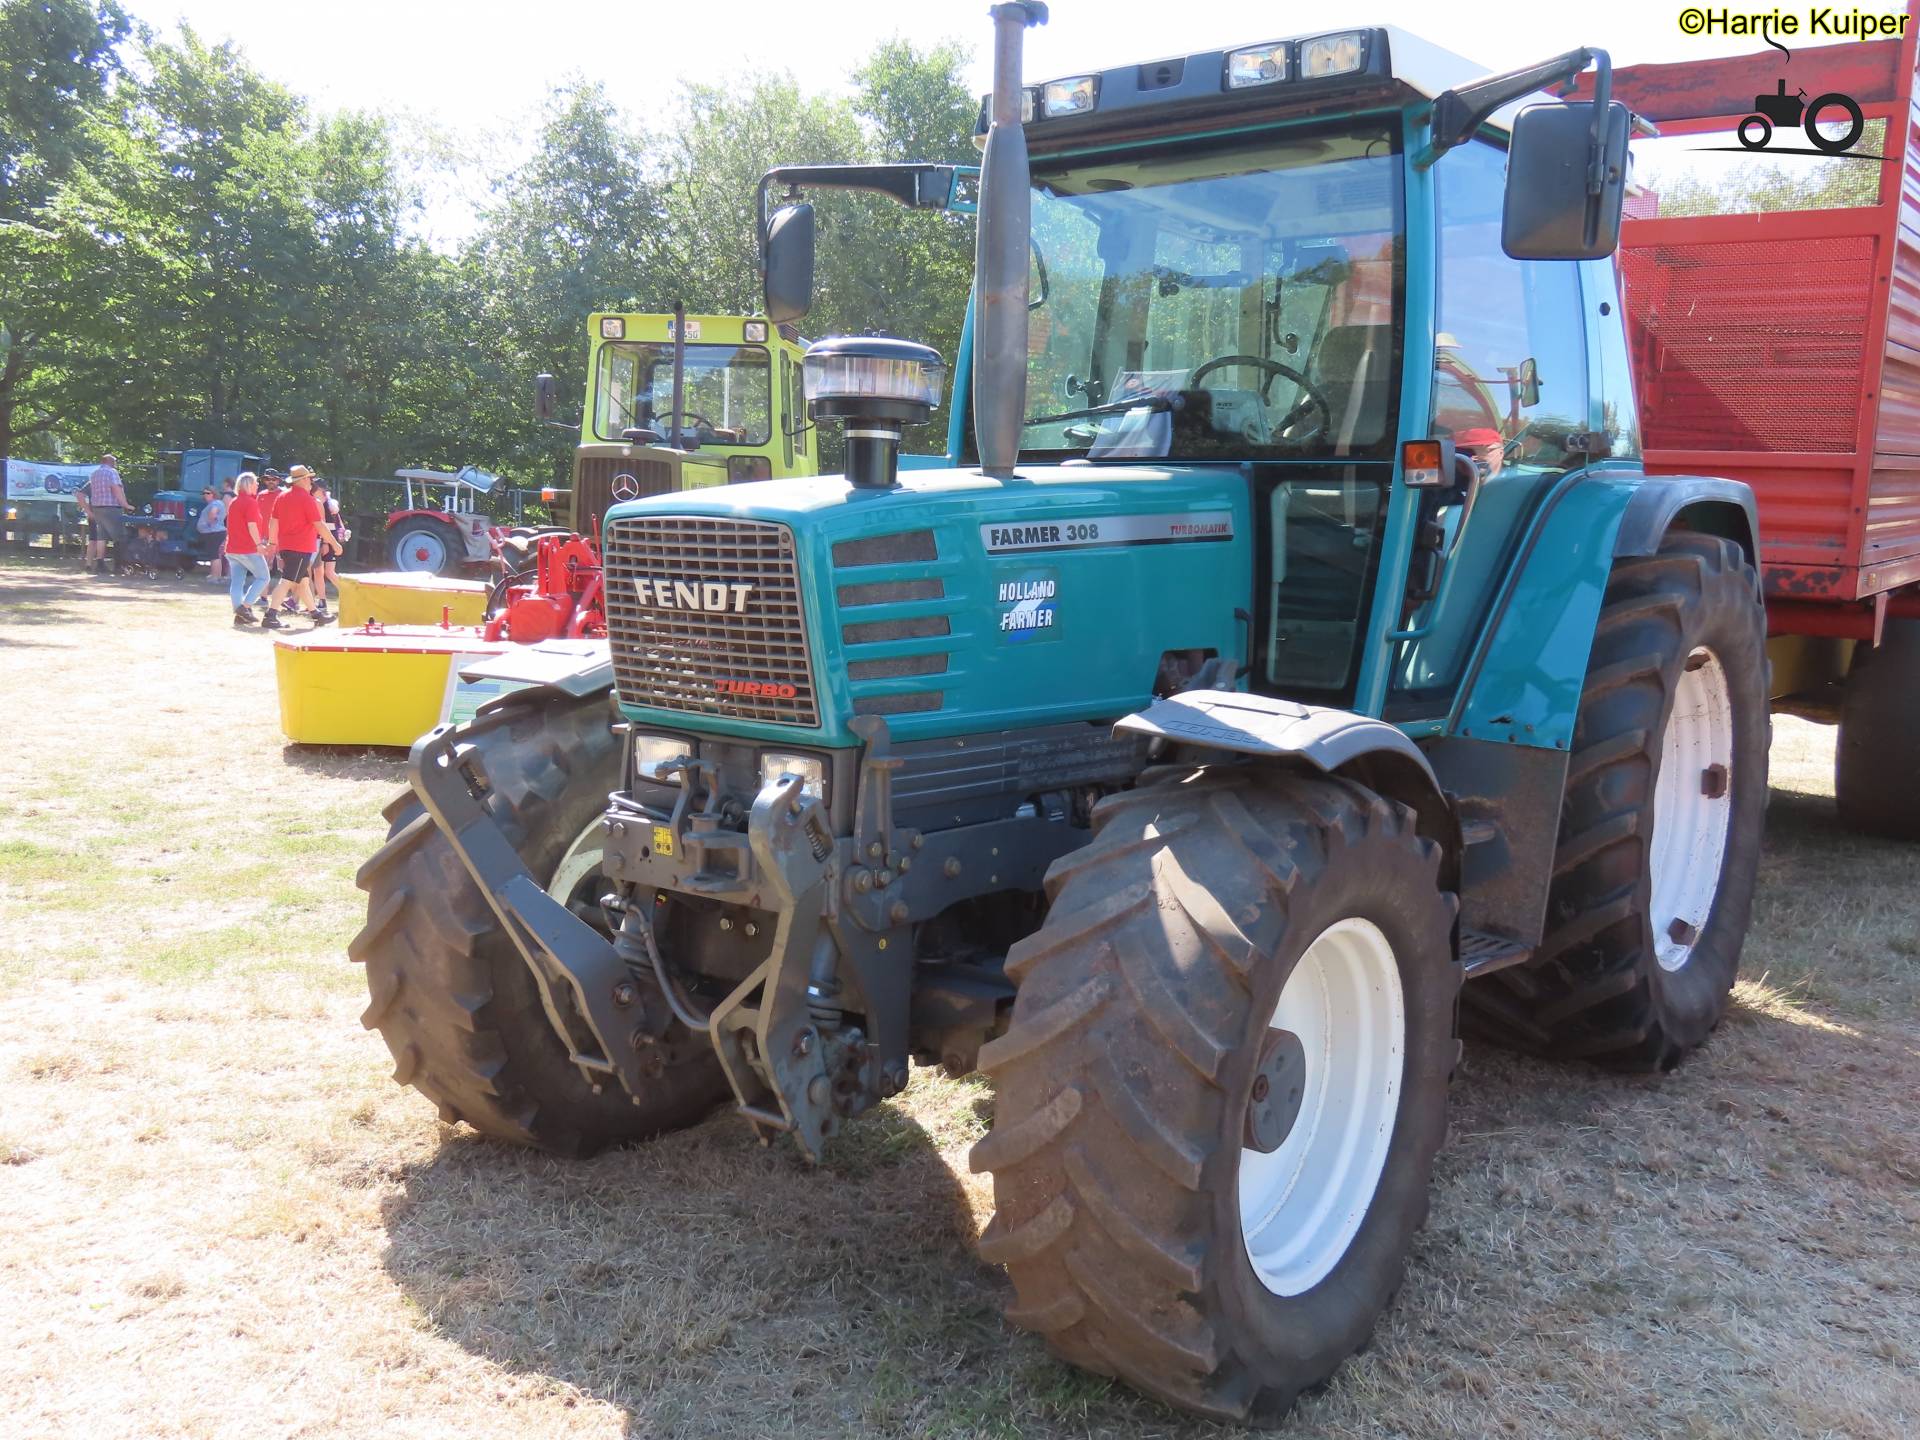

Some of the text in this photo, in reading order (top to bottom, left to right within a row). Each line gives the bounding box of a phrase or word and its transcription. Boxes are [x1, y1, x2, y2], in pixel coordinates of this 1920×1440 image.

[991, 524, 1099, 546] FARMER 308
[633, 576, 755, 613] FENDT
[999, 580, 1055, 601] HOLLAND
[1000, 608, 1053, 631] FARMER
[714, 679, 797, 698] TURBO
